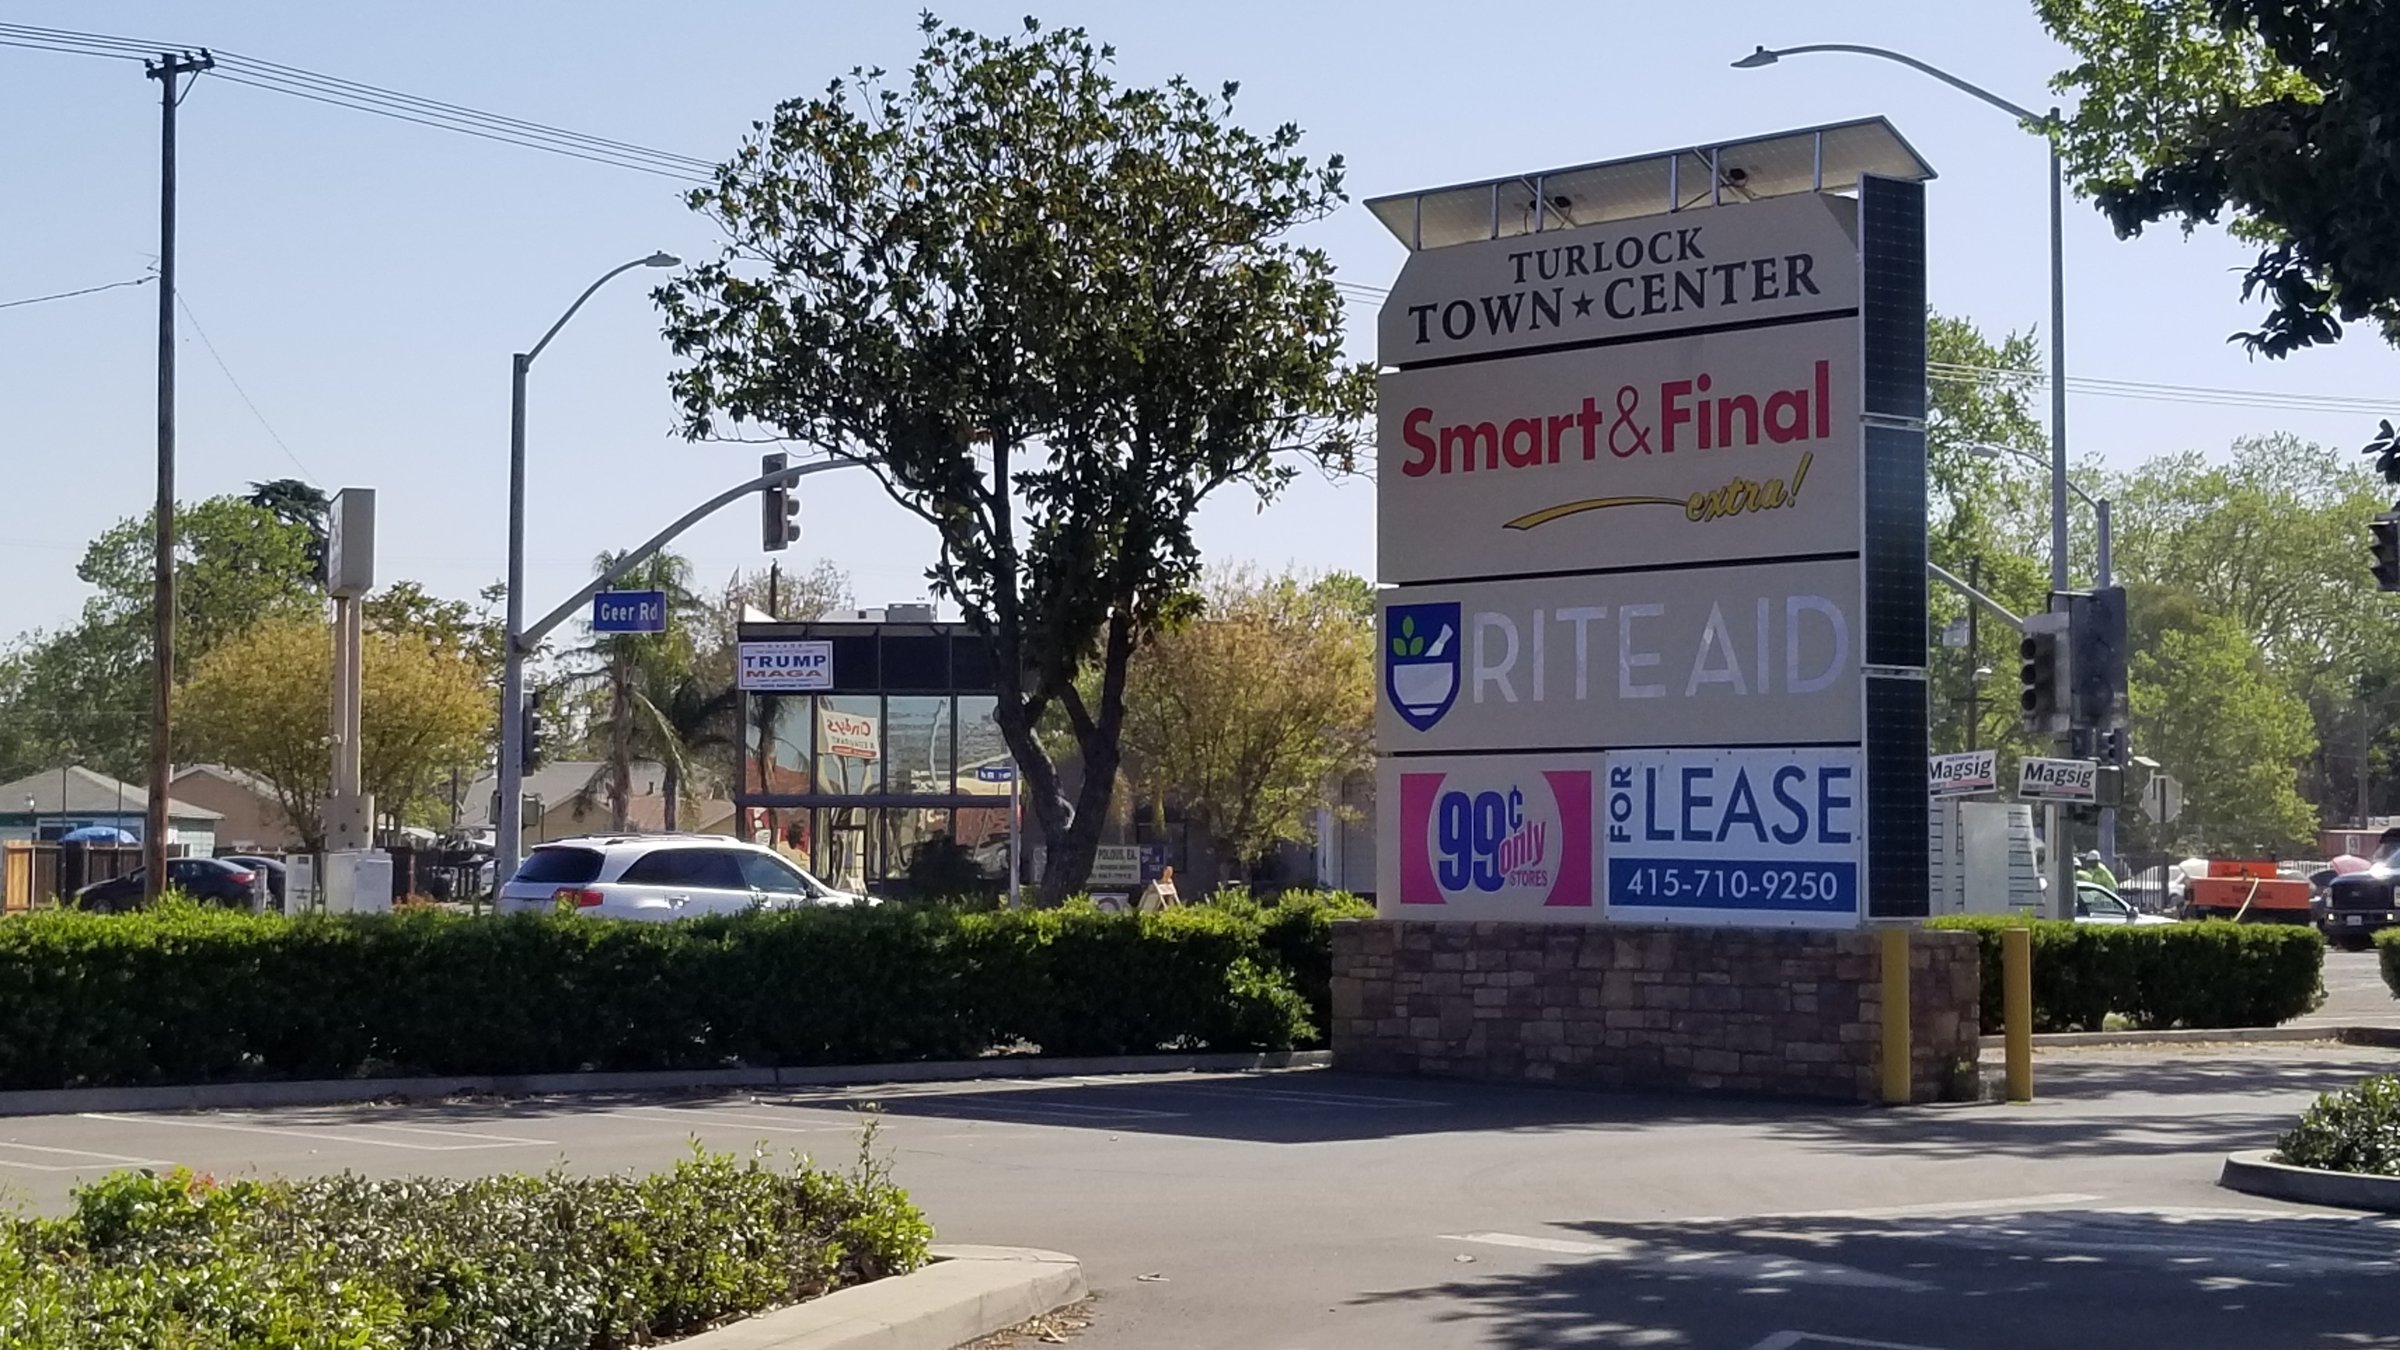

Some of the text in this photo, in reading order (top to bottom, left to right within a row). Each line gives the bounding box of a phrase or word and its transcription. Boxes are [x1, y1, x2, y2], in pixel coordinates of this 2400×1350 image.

[1508, 226, 1706, 284] TURLOCK
[1408, 253, 1821, 345] TOWN CENTER
[1685, 451, 1813, 523] extra!
[601, 602, 658, 621] Geer Rd
[743, 655, 826, 668] TRUMP
[1472, 595, 1850, 704] RITE AID
[746, 670, 822, 678] MAGA
[1929, 759, 1993, 781] Magsig
[2024, 762, 2094, 788] Magsig
[1610, 765, 1852, 845] FOR LEASE
[1499, 820, 1546, 876] only
[1510, 870, 1548, 888] STORES
[1627, 867, 1838, 901] 415-710-9250
